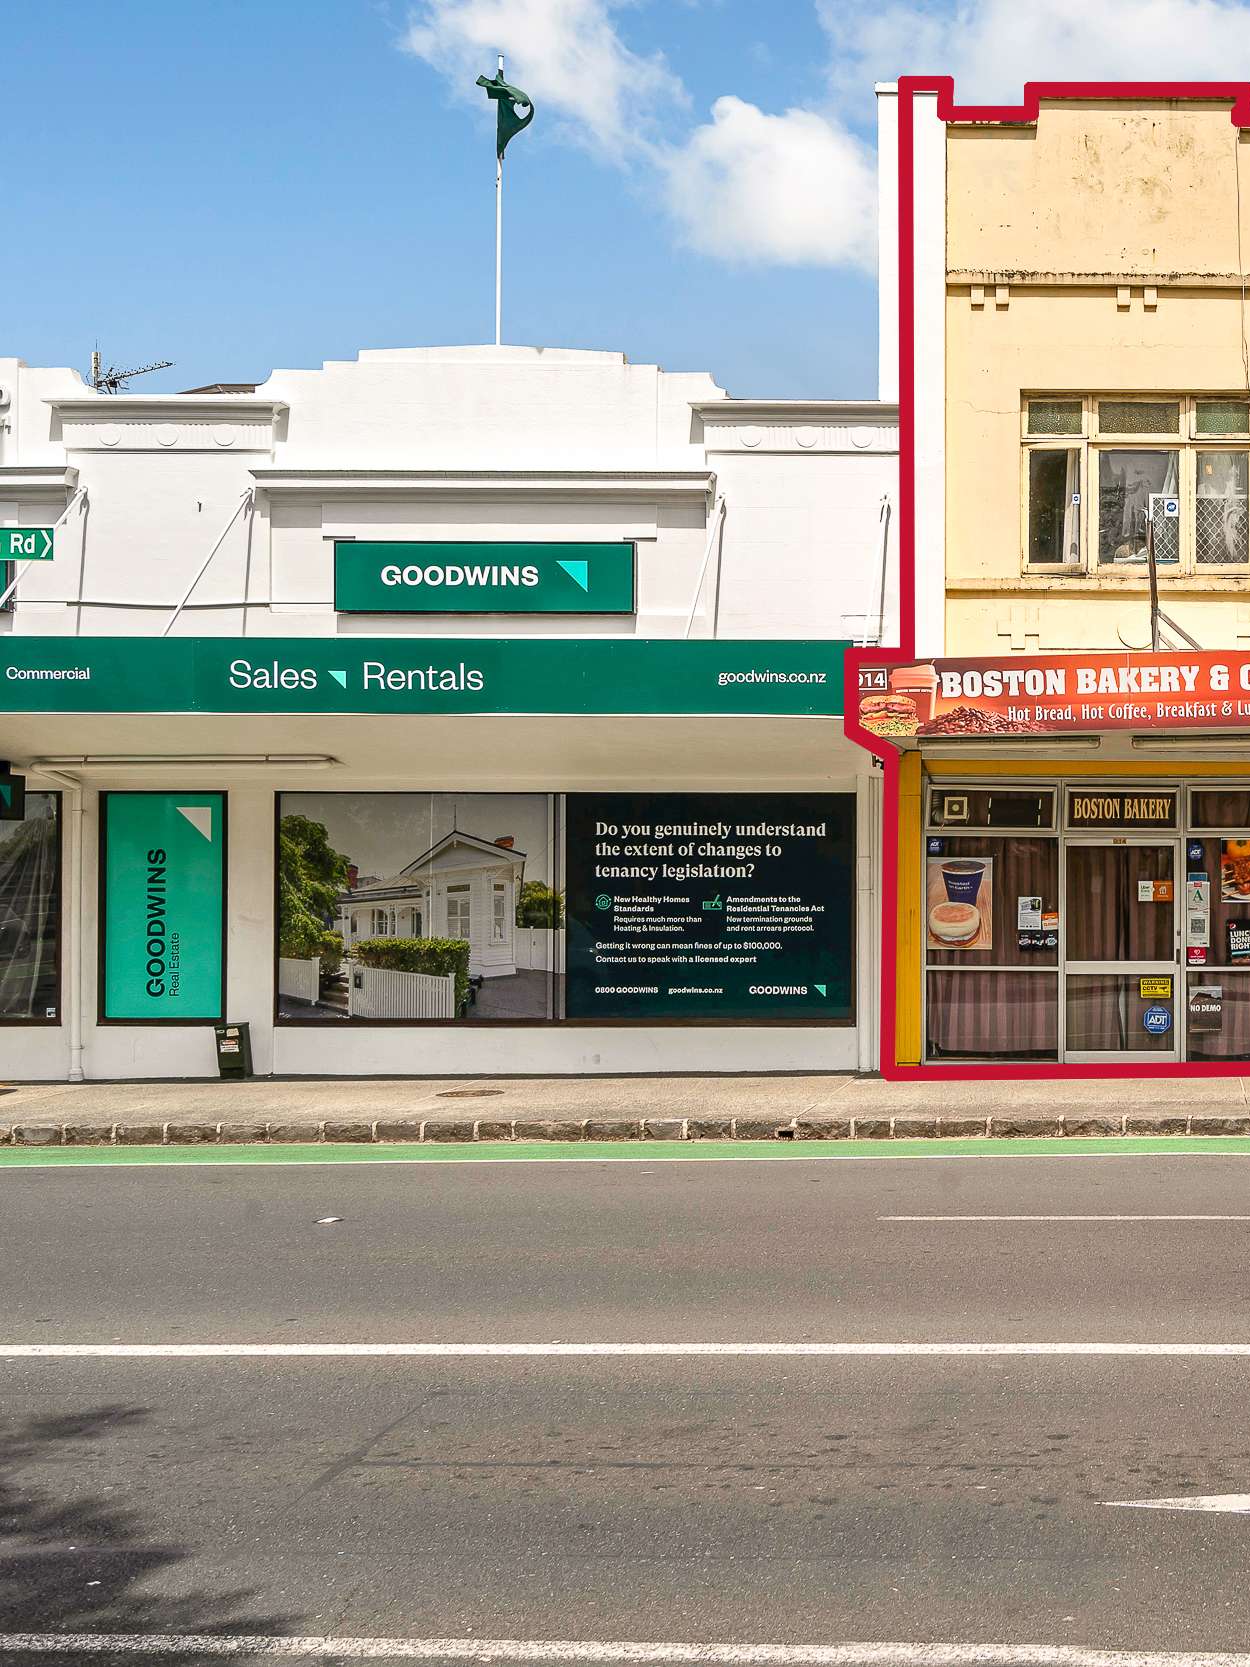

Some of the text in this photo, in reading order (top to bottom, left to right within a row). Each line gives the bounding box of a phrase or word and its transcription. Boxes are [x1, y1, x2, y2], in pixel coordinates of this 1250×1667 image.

[10, 533, 35, 553] Rd
[380, 564, 539, 588] GOODWINS
[6, 667, 90, 680] Commercial
[229, 660, 484, 692] Sales Rentals
[718, 670, 826, 686] goodwins.co.nz
[941, 669, 1066, 698] BOSTON
[1076, 665, 1200, 695] BAKERY
[1209, 665, 1230, 691] &
[1008, 705, 1030, 721] Hot
[1035, 704, 1076, 722] Bread,
[1081, 703, 1103, 720] Hot
[1109, 702, 1152, 721] Coffee,
[1157, 700, 1216, 719] Breakfast
[1222, 701, 1232, 716] &
[1074, 798, 1171, 819] BOSTON BAKERY
[596, 822, 826, 839] Do you genuinely understand
[595, 842, 782, 859] the extent of changes to
[595, 863, 755, 881] tenancy legislation?
[632, 896, 661, 904] Healthy
[146, 848, 166, 997] GOODWINS
[613, 915, 645, 923] Requires
[646, 915, 666, 923] much
[686, 915, 702, 923] than
[783, 916, 813, 924] grounds
[613, 925, 641, 933] Heating
[595, 942, 625, 950] Getting
[743, 942, 783, 950] $100,000.
[169, 932, 179, 996] Real Estate
[595, 955, 627, 963] Contact
[647, 956, 671, 964] speak
[671, 955, 688, 963] with
[695, 955, 728, 963] licensed
[730, 956, 757, 964] expert
[595, 986, 659, 994] 0800 GOODWINS
[668, 987, 724, 995] goodwins.co.nz
[749, 986, 808, 995] GOODWINS
[1149, 1015, 1167, 1024] ADT
